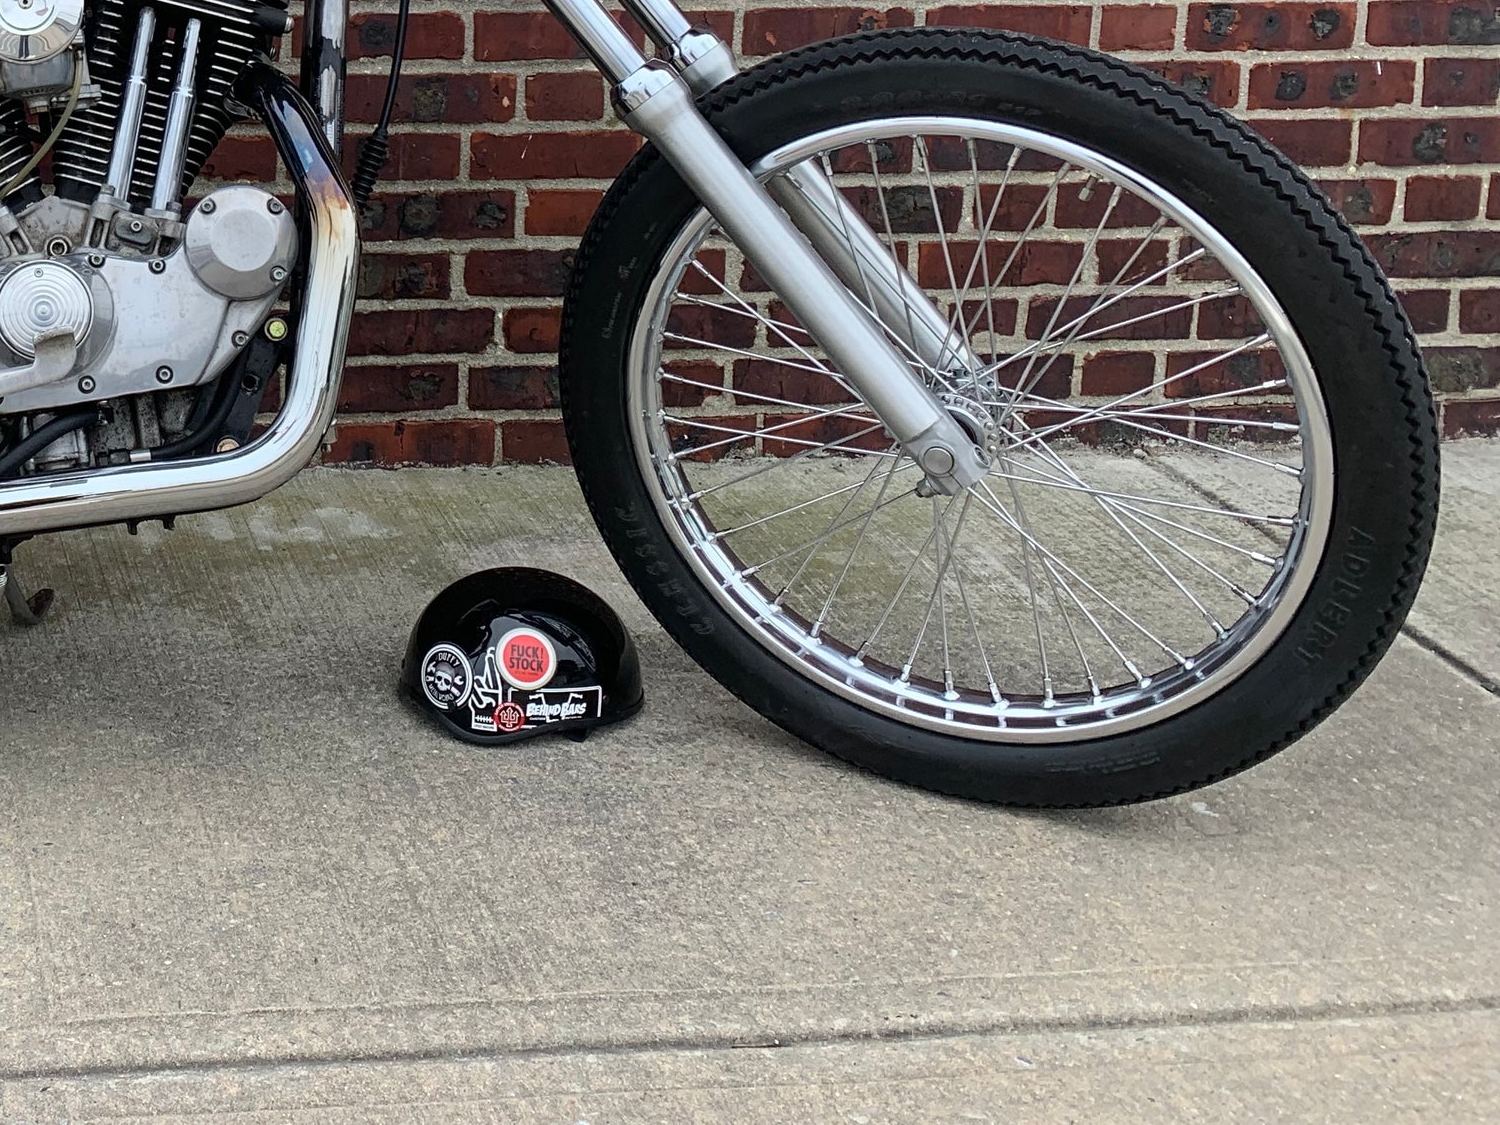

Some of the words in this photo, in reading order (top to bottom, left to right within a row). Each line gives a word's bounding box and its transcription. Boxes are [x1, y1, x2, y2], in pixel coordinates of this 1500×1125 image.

[509, 657, 544, 672] STOCK
[526, 702, 561, 717] BEHIND
[560, 702, 587, 717] BARS
